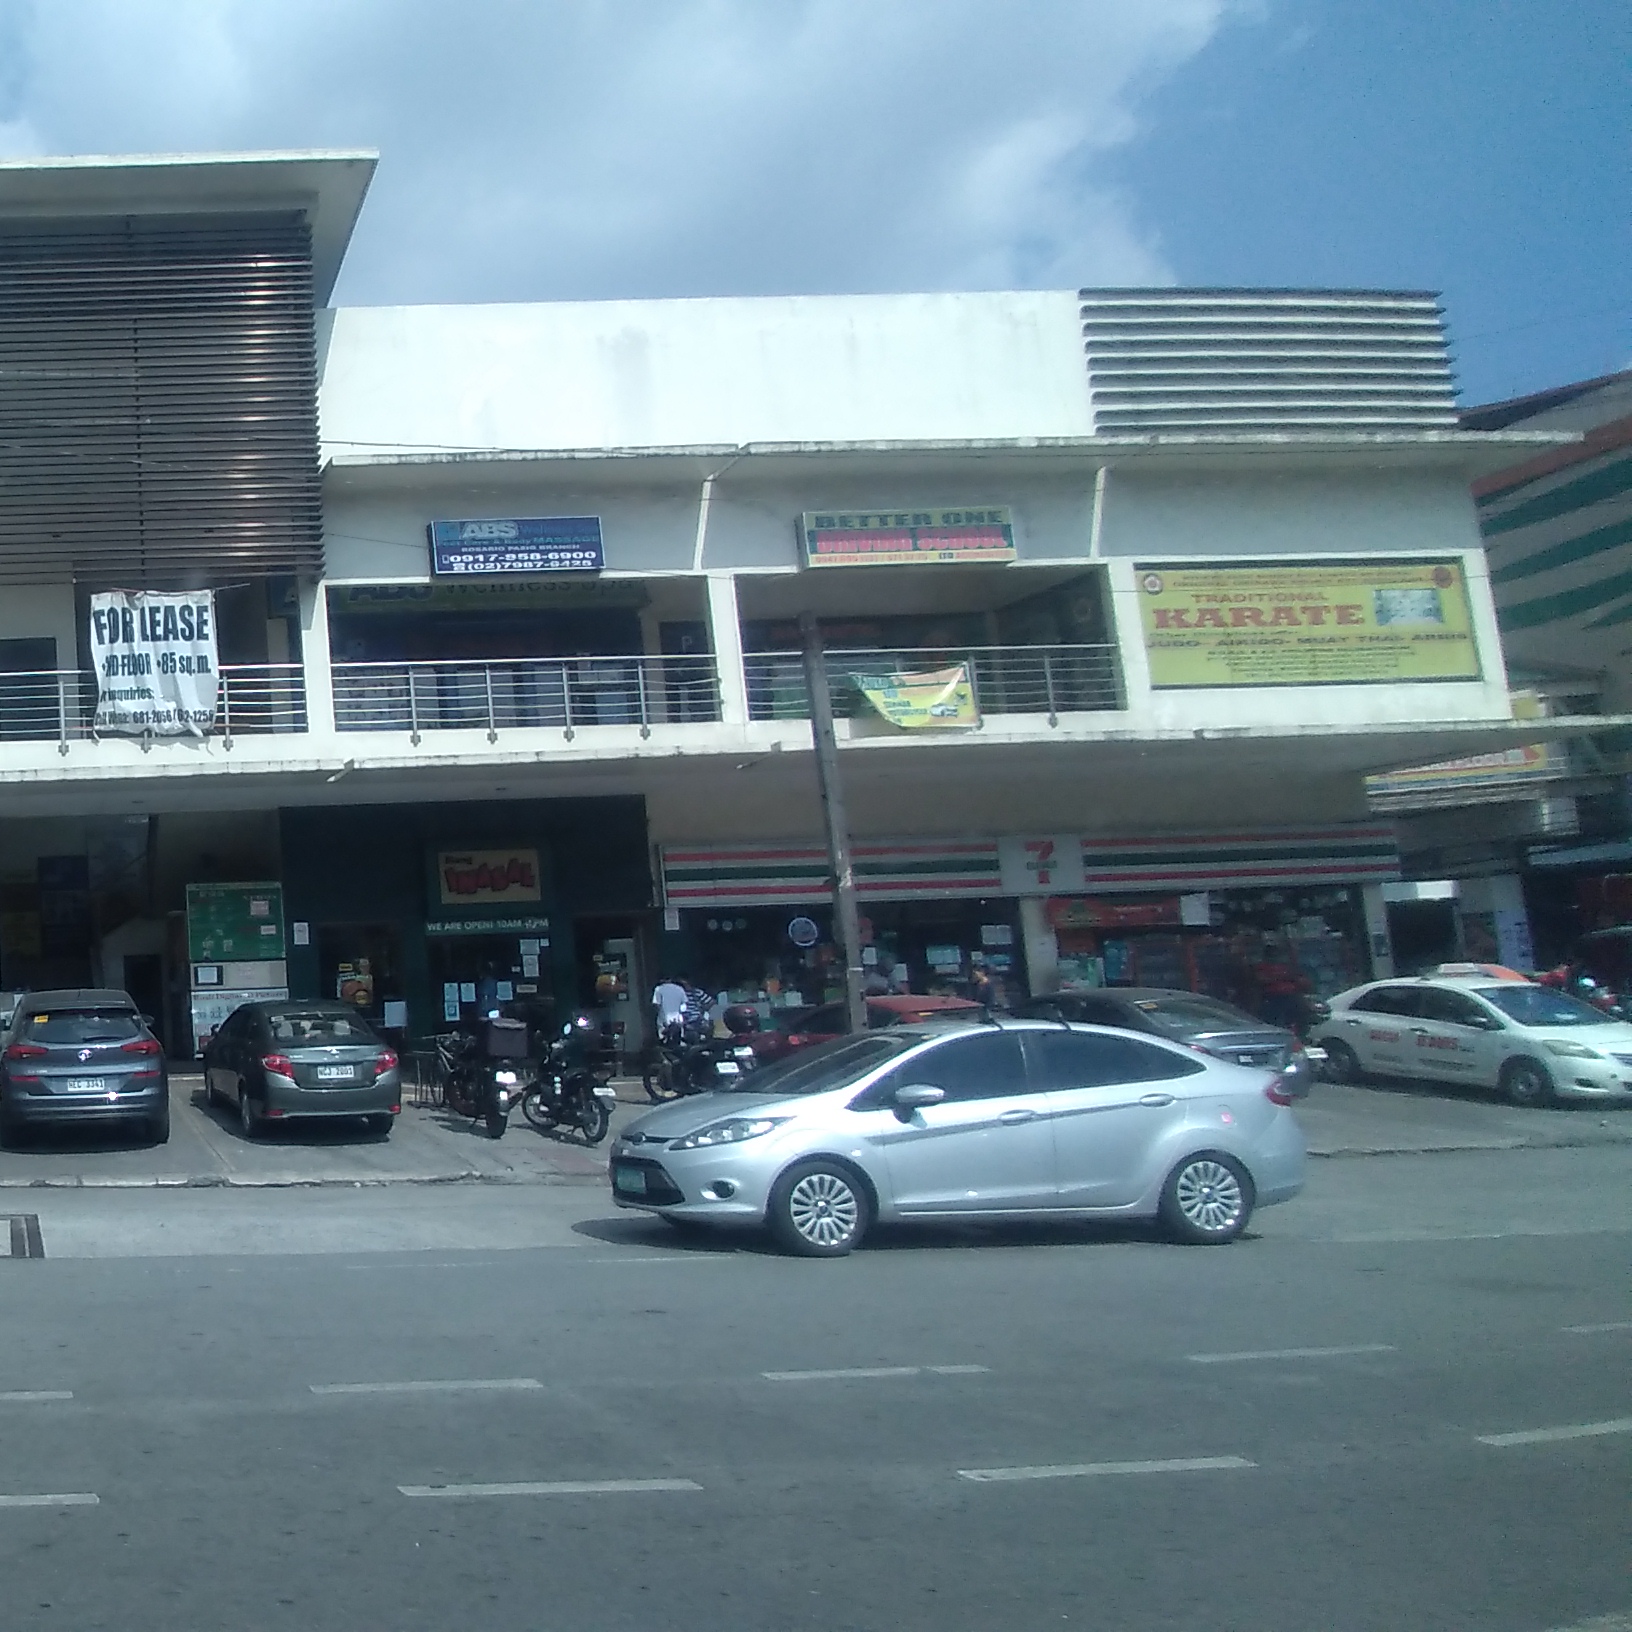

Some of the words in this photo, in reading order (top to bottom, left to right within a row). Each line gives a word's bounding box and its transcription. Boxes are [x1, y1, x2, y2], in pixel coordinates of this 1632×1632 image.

[461, 521, 519, 539] ABS
[1190, 592, 1329, 604] TRADITIONAL
[93, 606, 135, 645] FOR
[141, 605, 210, 642] LEASE
[1152, 604, 1365, 629] KARATE
[426, 922, 442, 931] WE
[444, 921, 461, 930] ARE
